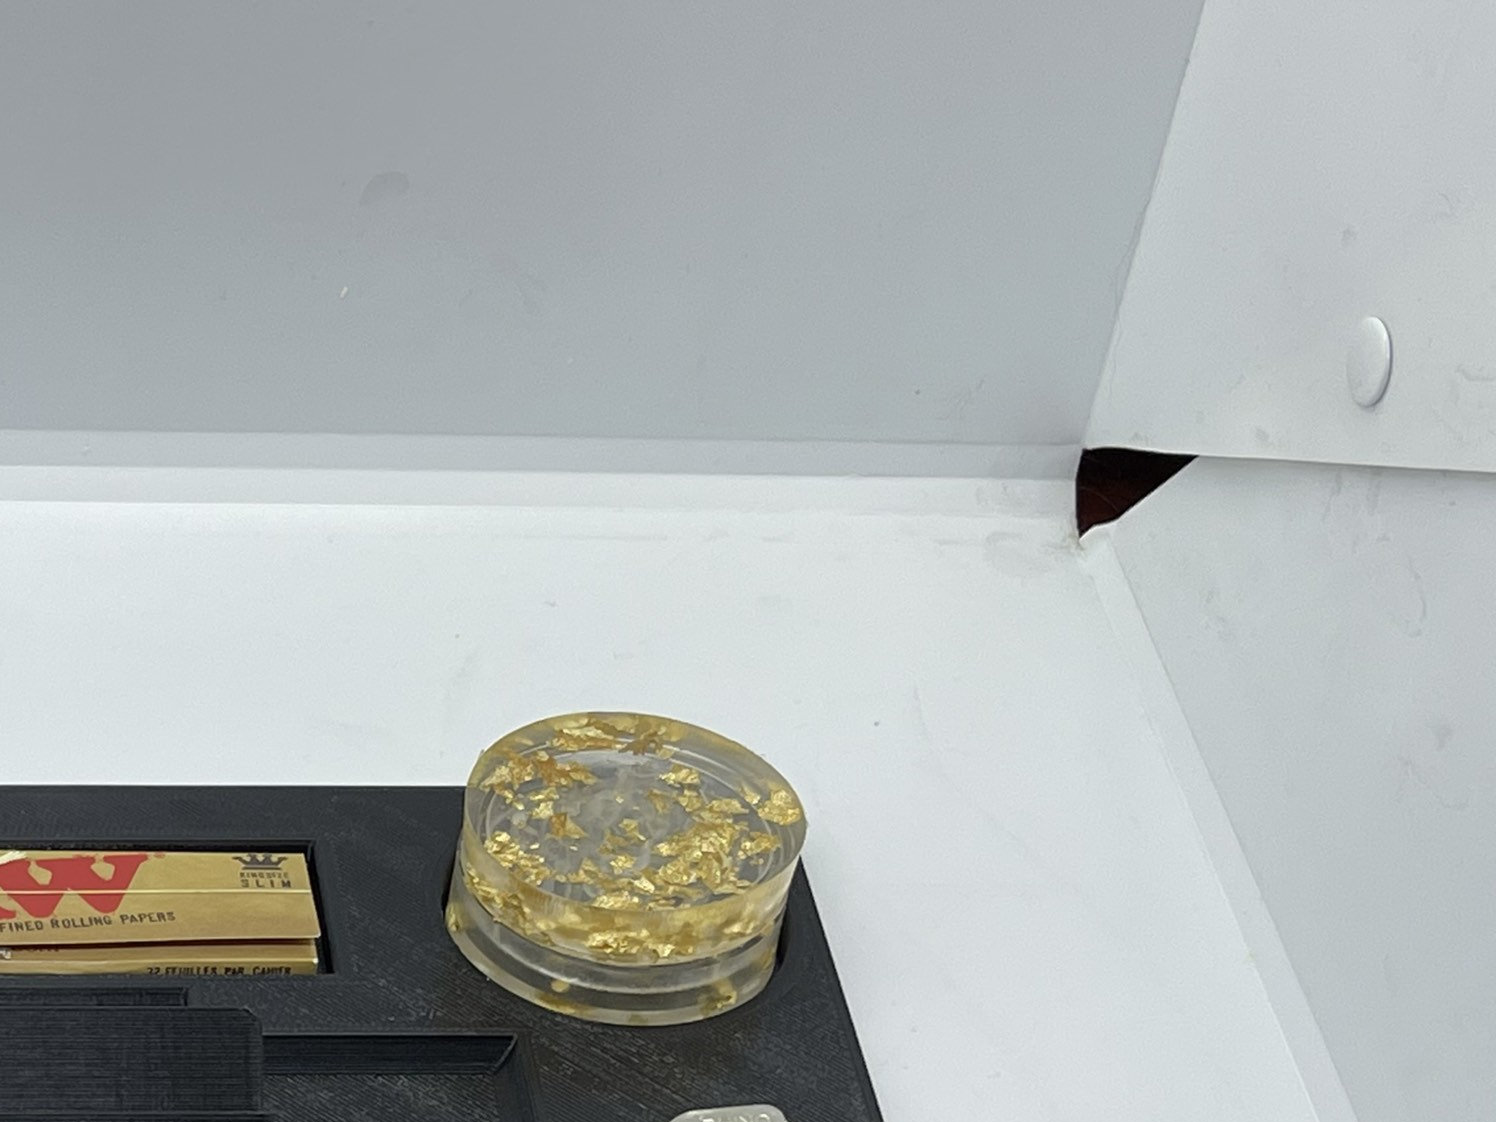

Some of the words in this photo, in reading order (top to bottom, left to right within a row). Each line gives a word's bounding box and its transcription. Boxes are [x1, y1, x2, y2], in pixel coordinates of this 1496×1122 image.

[240, 879, 291, 888] SLIM
[50, 916, 113, 929] ROLLING
[119, 911, 176, 925] PAPERS
